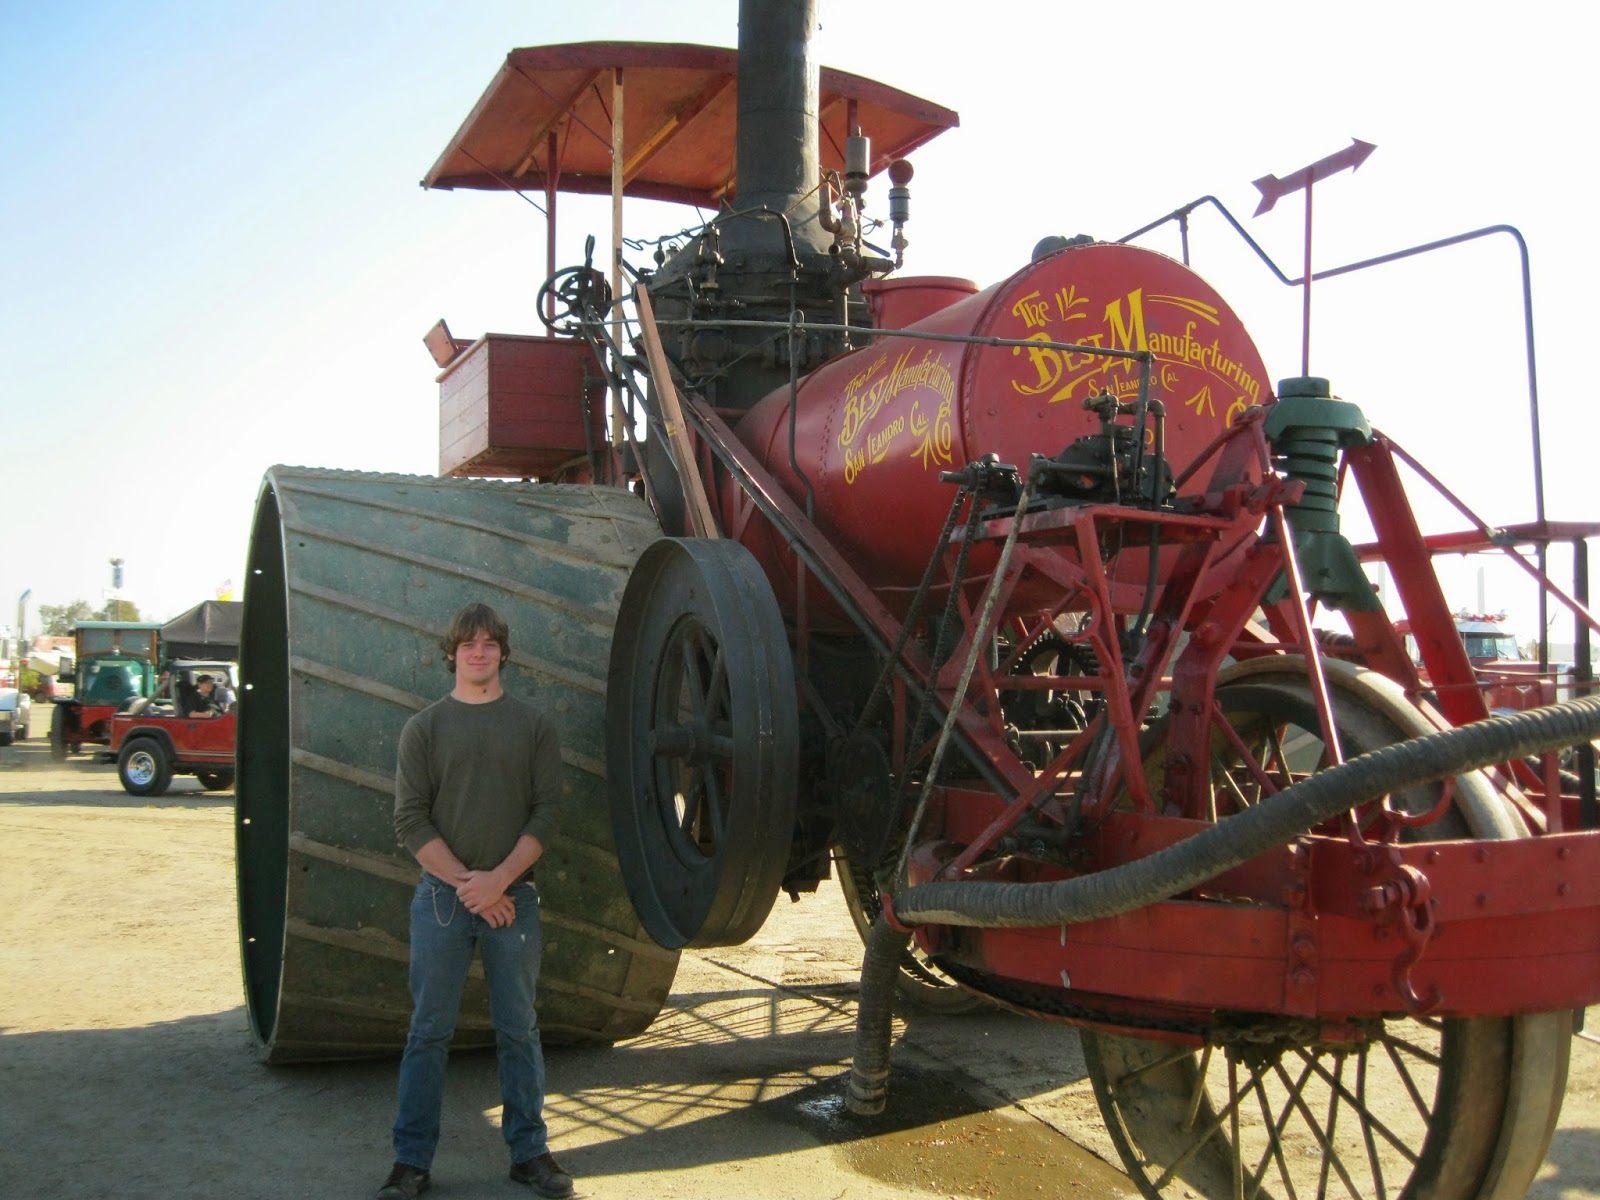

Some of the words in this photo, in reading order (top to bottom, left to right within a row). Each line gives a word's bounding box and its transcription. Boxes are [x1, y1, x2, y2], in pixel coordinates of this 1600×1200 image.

[1012, 290, 1053, 328] The
[1103, 288, 1260, 405] Manufacturing
[838, 375, 889, 450] BEST
[885, 345, 955, 405] Manufacturing
[844, 371, 867, 401] The
[844, 448, 866, 484] SAN
[867, 416, 905, 464] LEANDRO
